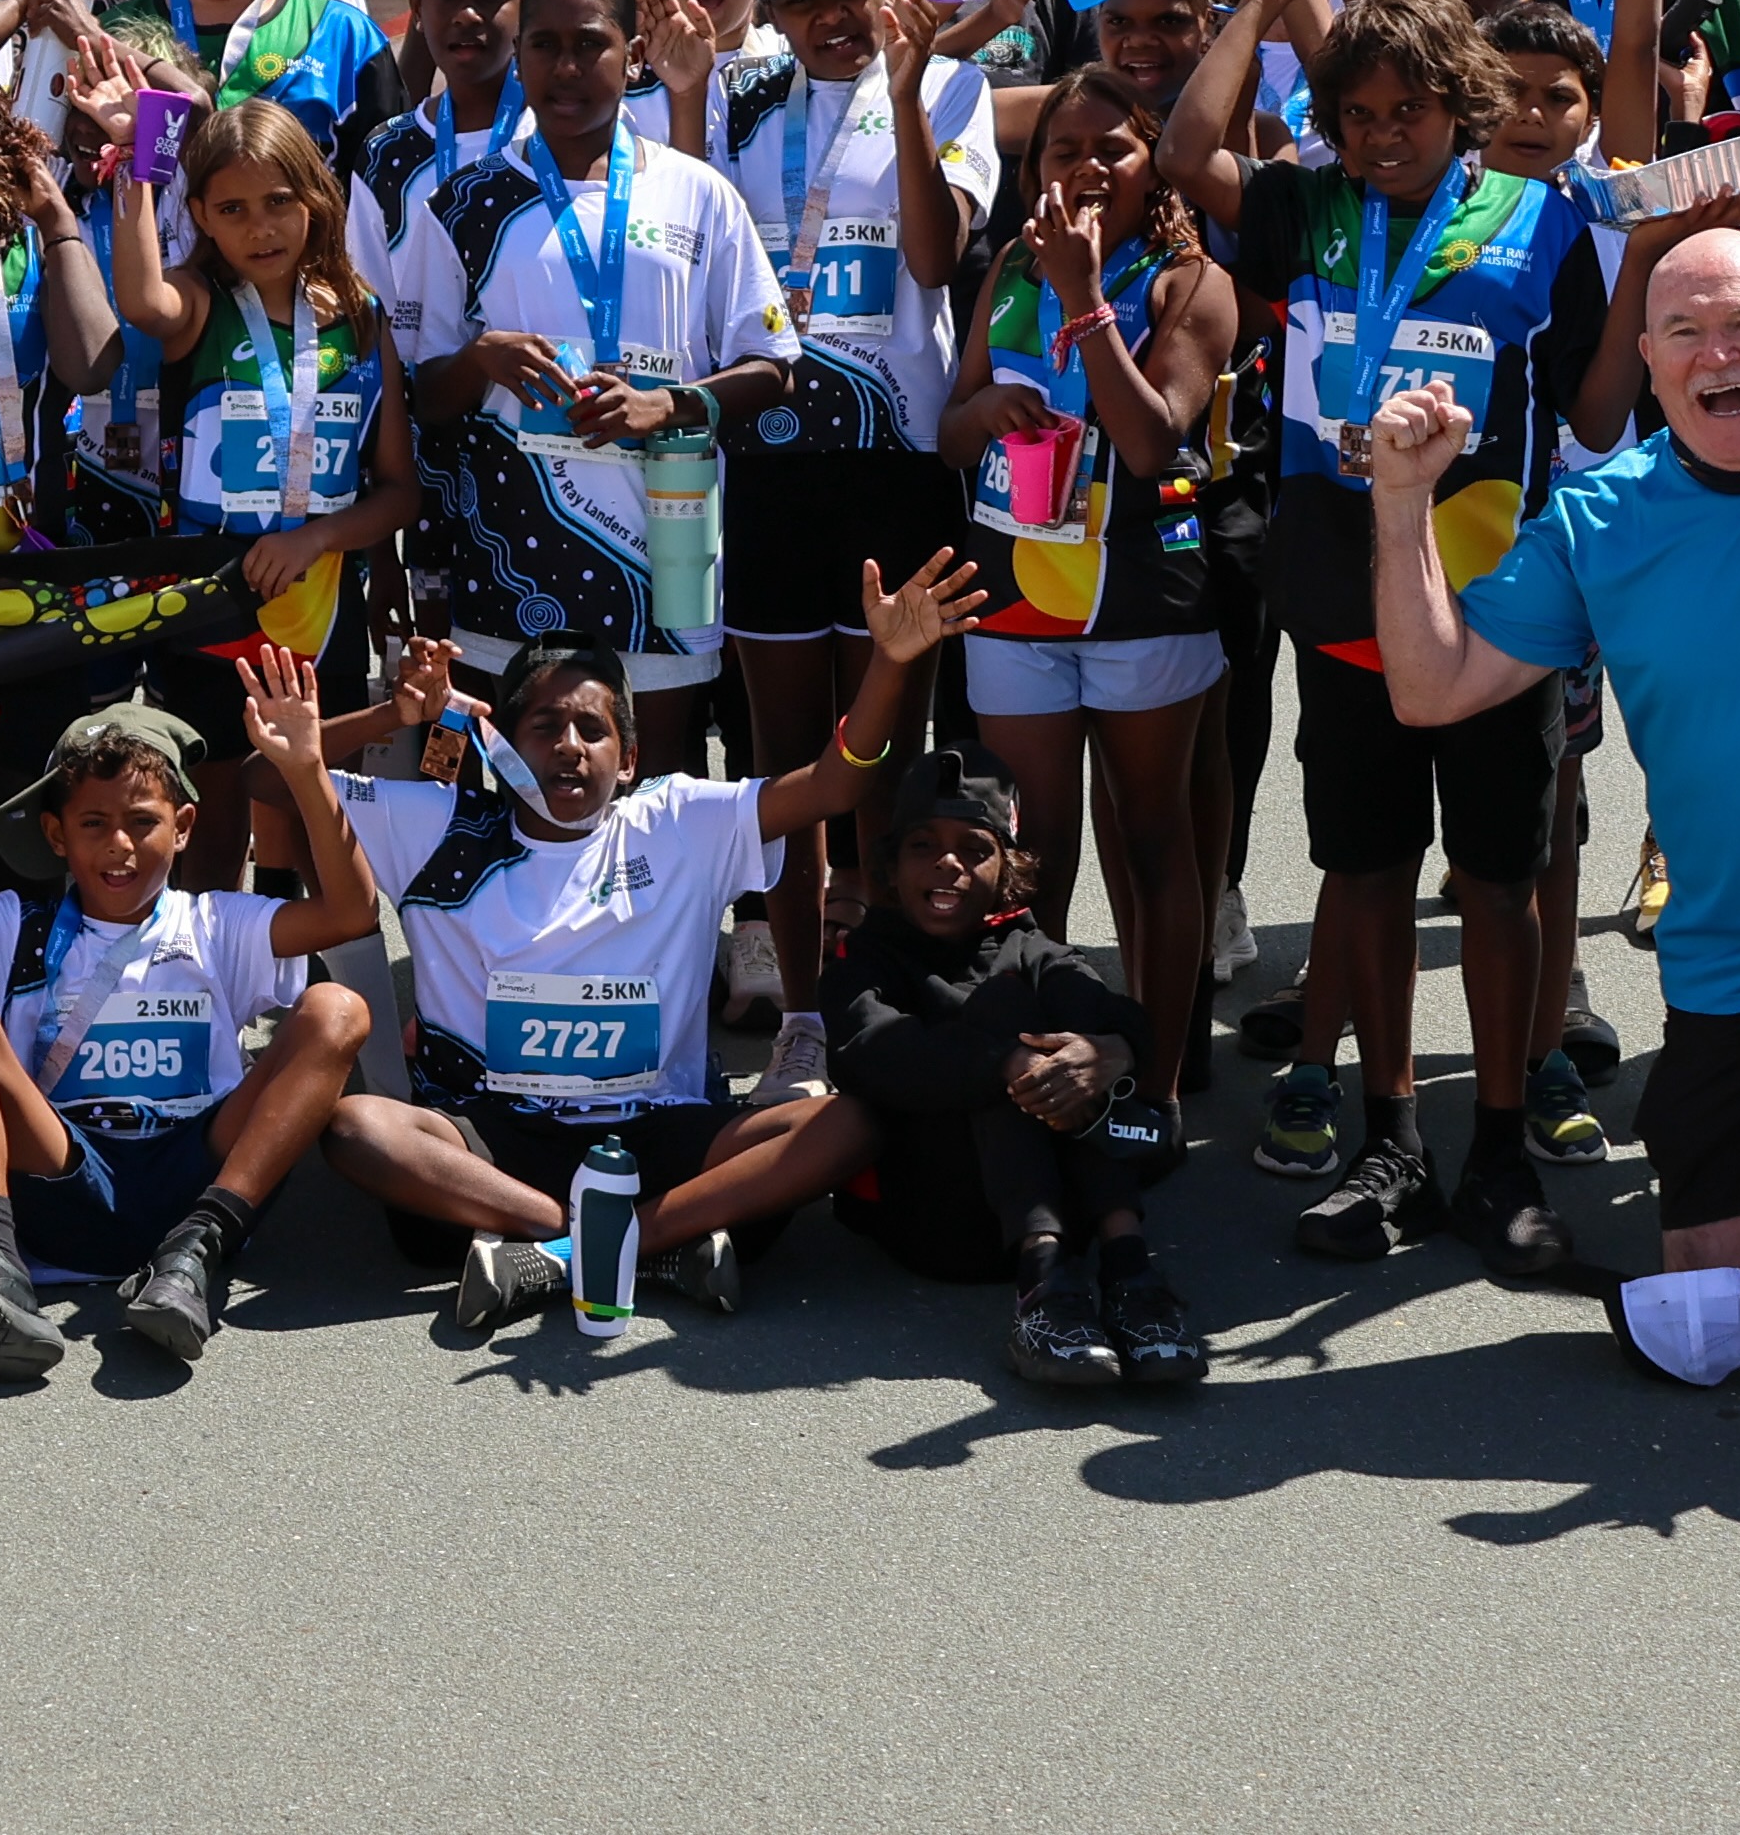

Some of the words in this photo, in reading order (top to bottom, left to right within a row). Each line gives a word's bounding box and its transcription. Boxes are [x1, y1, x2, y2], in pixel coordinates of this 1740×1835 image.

[827, 224, 886, 243] 2.5KM
[1481, 244, 1504, 256] IMF
[1506, 247, 1534, 261] RAW
[1415, 329, 1484, 355] 2.5KM
[622, 351, 674, 375] 2.5KM
[255, 437, 352, 477] 287
[984, 450, 1013, 494] 26
[561, 483, 585, 509] Ray
[584, 498, 631, 540] Landers
[581, 983, 647, 1002] 2.5KM
[135, 999, 201, 1018] 2.5KM
[519, 1019, 627, 1059] 2727
[79, 1038, 183, 1081] 2695
